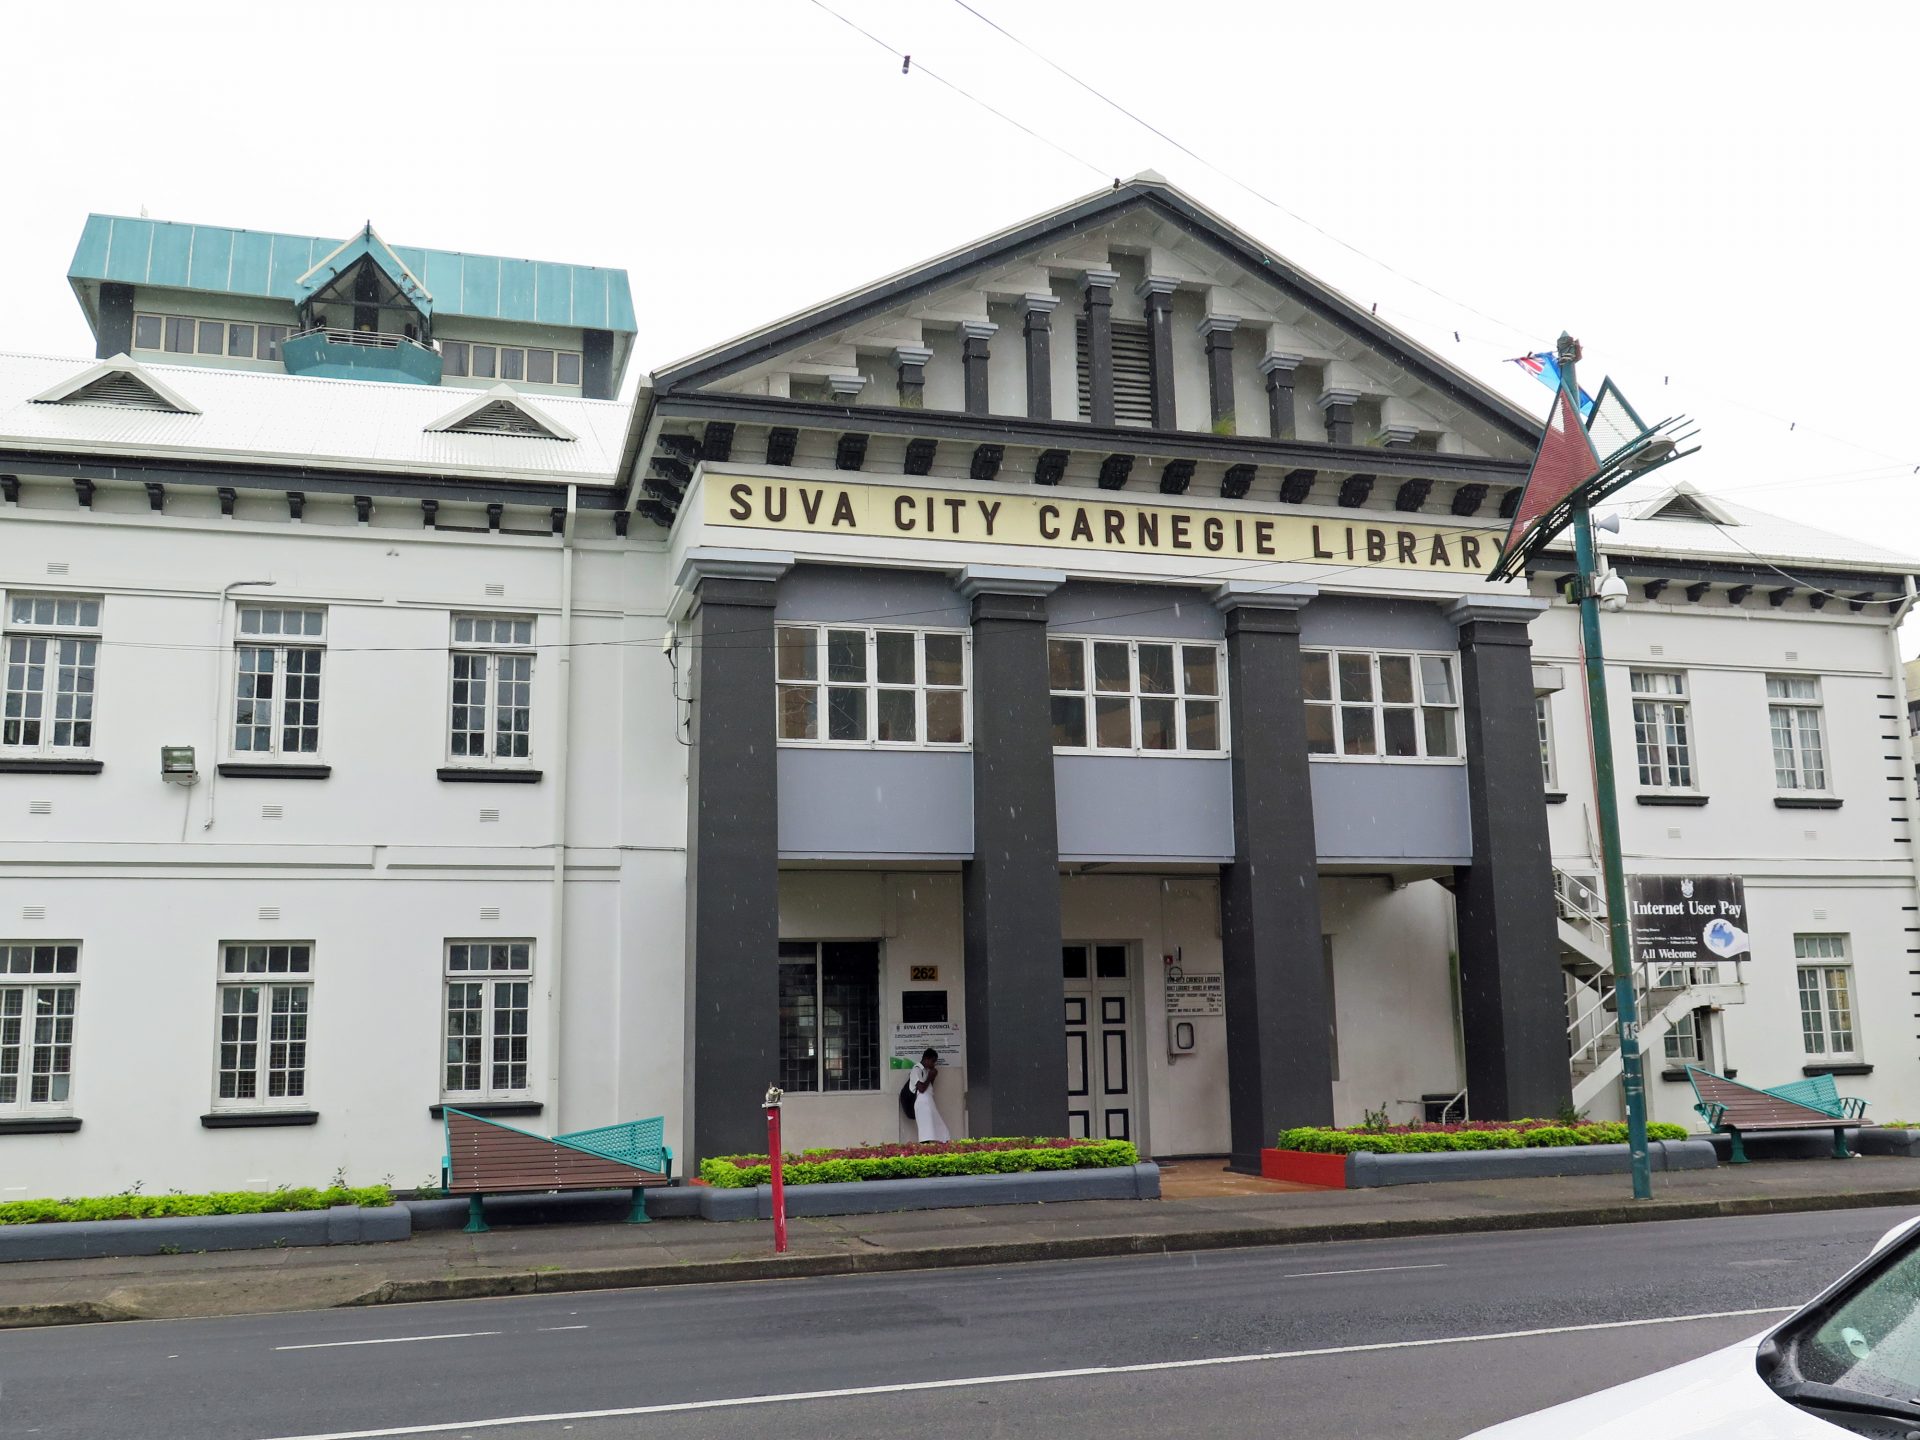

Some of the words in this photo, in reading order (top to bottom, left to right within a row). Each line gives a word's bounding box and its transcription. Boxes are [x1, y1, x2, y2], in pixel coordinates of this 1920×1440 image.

[729, 483, 857, 528] SUVA
[894, 495, 1002, 536] CITY
[1039, 504, 1276, 555] CARNEGIE
[1633, 900, 1685, 915] Internet
[1688, 900, 1717, 915] User
[1718, 900, 1742, 918] Pay
[1641, 949, 1656, 959] All
[1659, 948, 1697, 959] Welcome
[912, 967, 936, 980] 262
